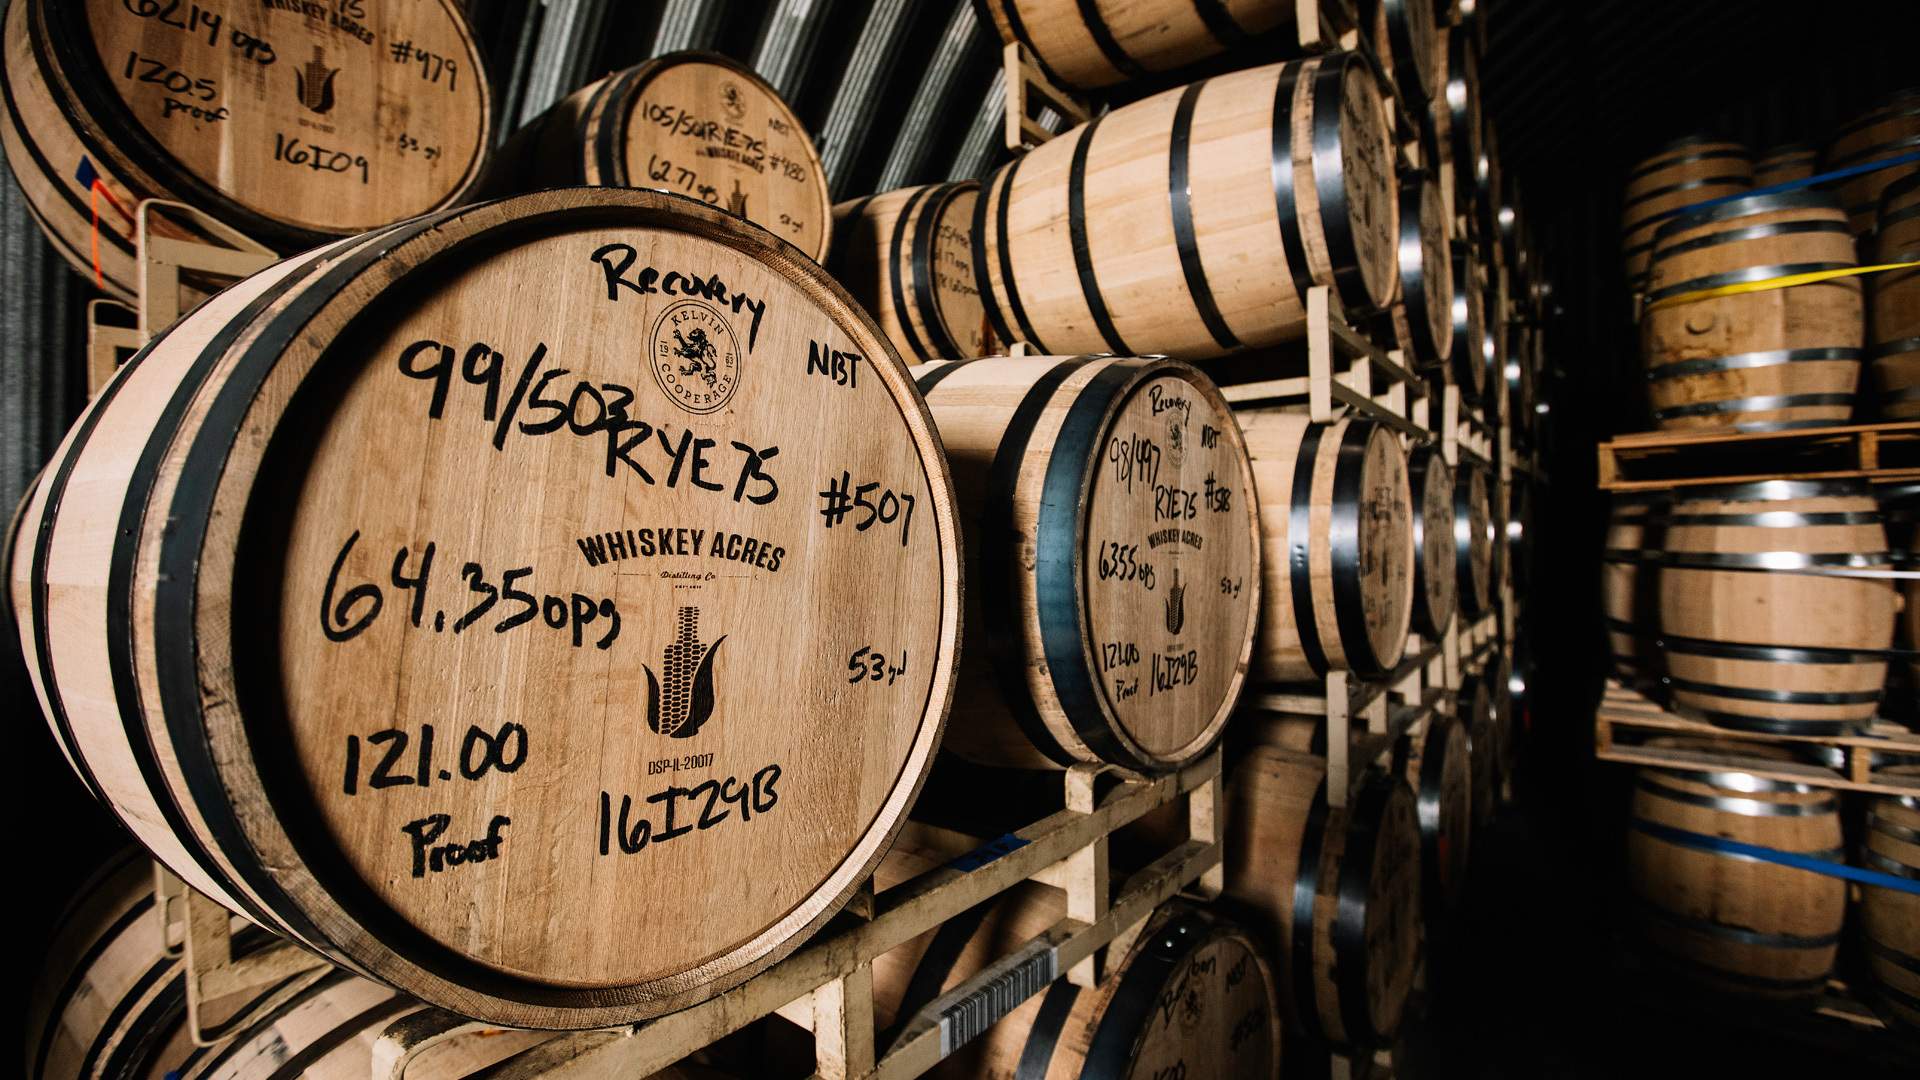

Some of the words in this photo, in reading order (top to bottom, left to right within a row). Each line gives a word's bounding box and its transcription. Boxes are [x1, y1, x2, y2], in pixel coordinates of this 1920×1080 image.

[331, 11, 375, 46] ACRES
[124, 51, 217, 102] 120.5
[390, 40, 458, 92] #479
[590, 243, 766, 354] Recovery
[671, 310, 725, 335] KELVIN
[661, 362, 732, 404] COOPERAGE
[807, 339, 863, 388] NBT
[398, 340, 636, 452] 99/503
[604, 418, 780, 505] RYE75
[1149, 385, 1192, 427] Recovery
[1109, 432, 1161, 495] 98/497
[1154, 485, 1199, 523] RYE75
[819, 471, 915, 547] #507
[577, 528, 706, 568] WHISKEY
[710, 531, 786, 573] ACRES
[1147, 528, 1180, 550] WHISKEY
[1181, 529, 1203, 551] ACRES
[660, 571, 702, 581] Distilling
[1102, 640, 1140, 673] 121.00
[343, 721, 529, 796] 121.00
[647, 752, 714, 776] DSP-IL-20017
[402, 815, 511, 879] Proof
